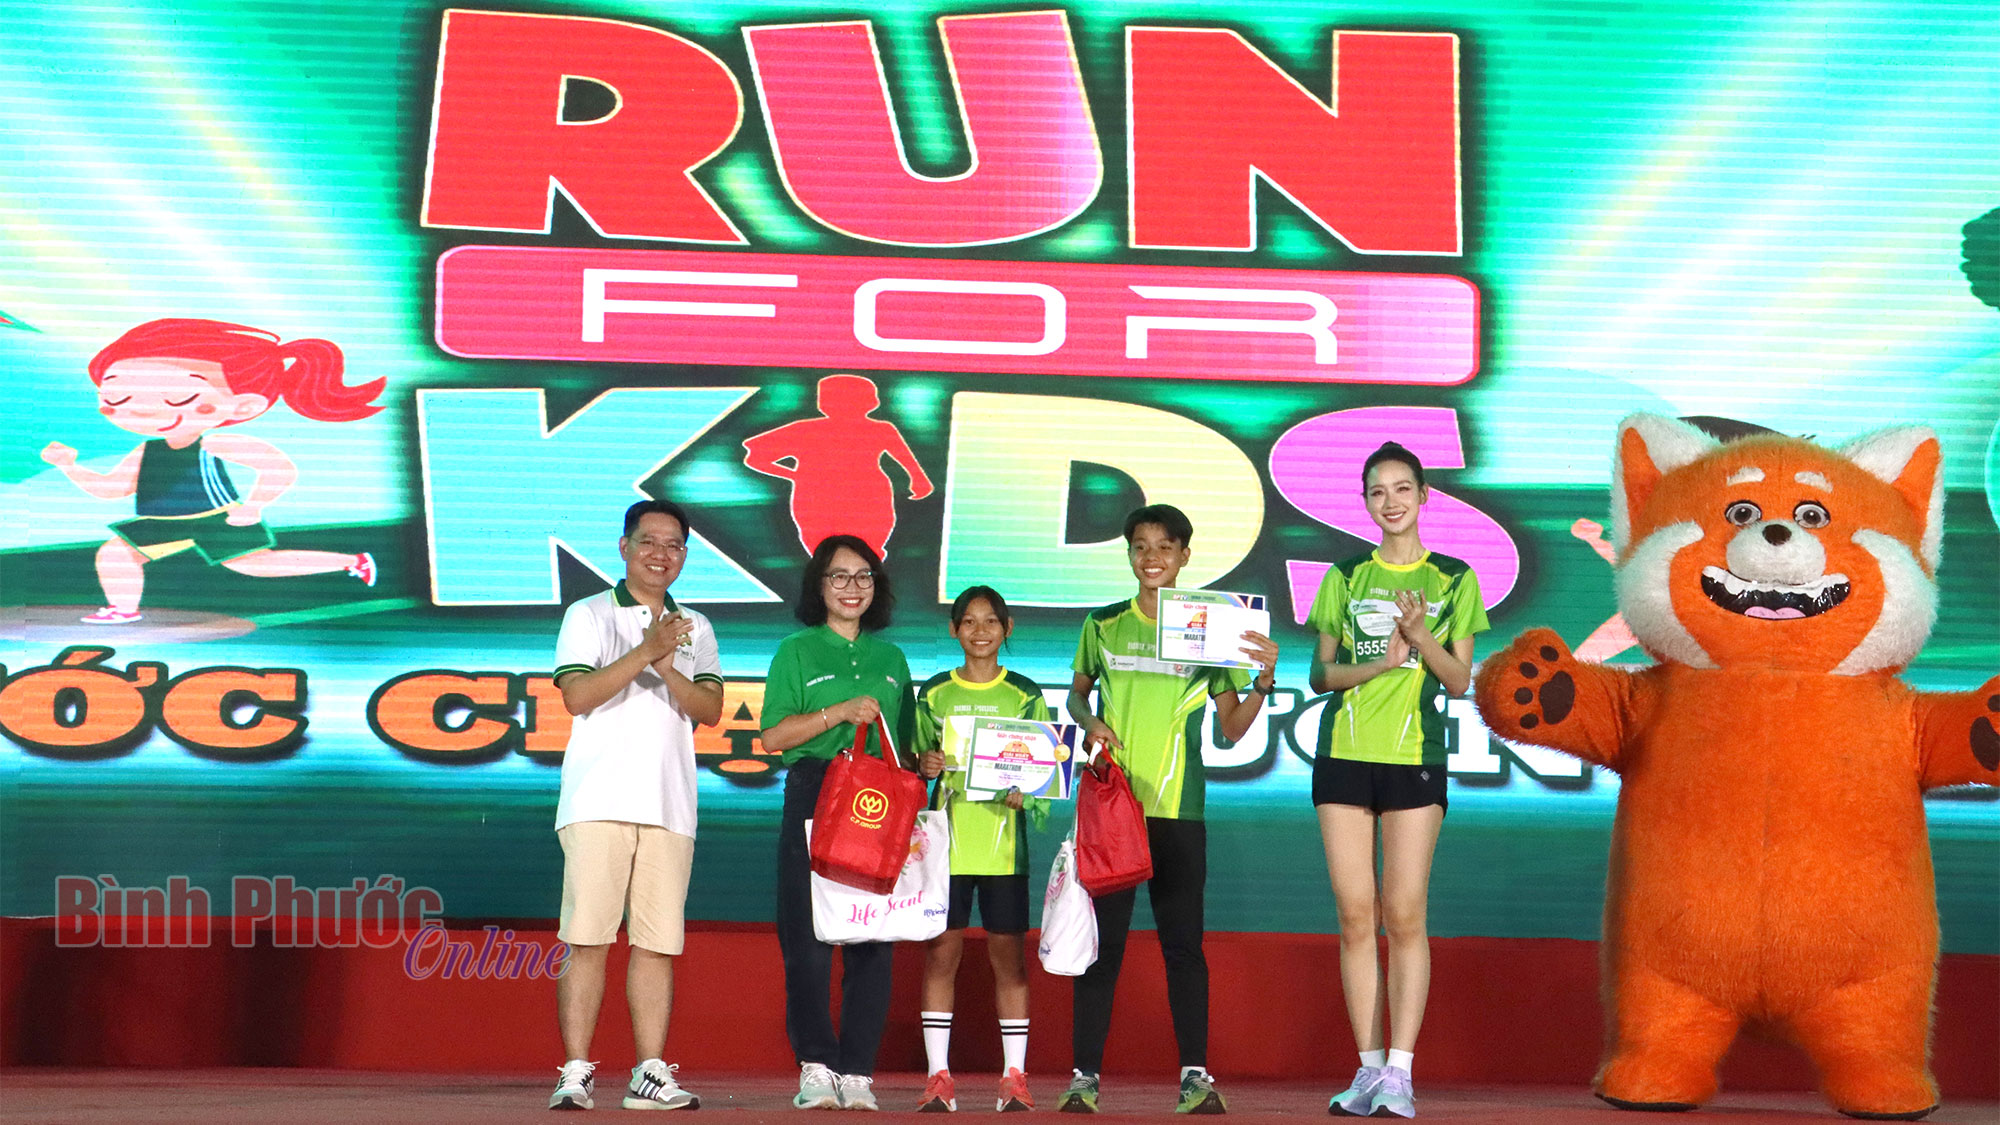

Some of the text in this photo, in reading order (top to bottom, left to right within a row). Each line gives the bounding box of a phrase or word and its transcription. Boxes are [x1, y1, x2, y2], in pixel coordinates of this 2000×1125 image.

[420, 8, 1463, 258] RUN
[581, 267, 1339, 366] FOR
[846, 902, 878, 926] Life
